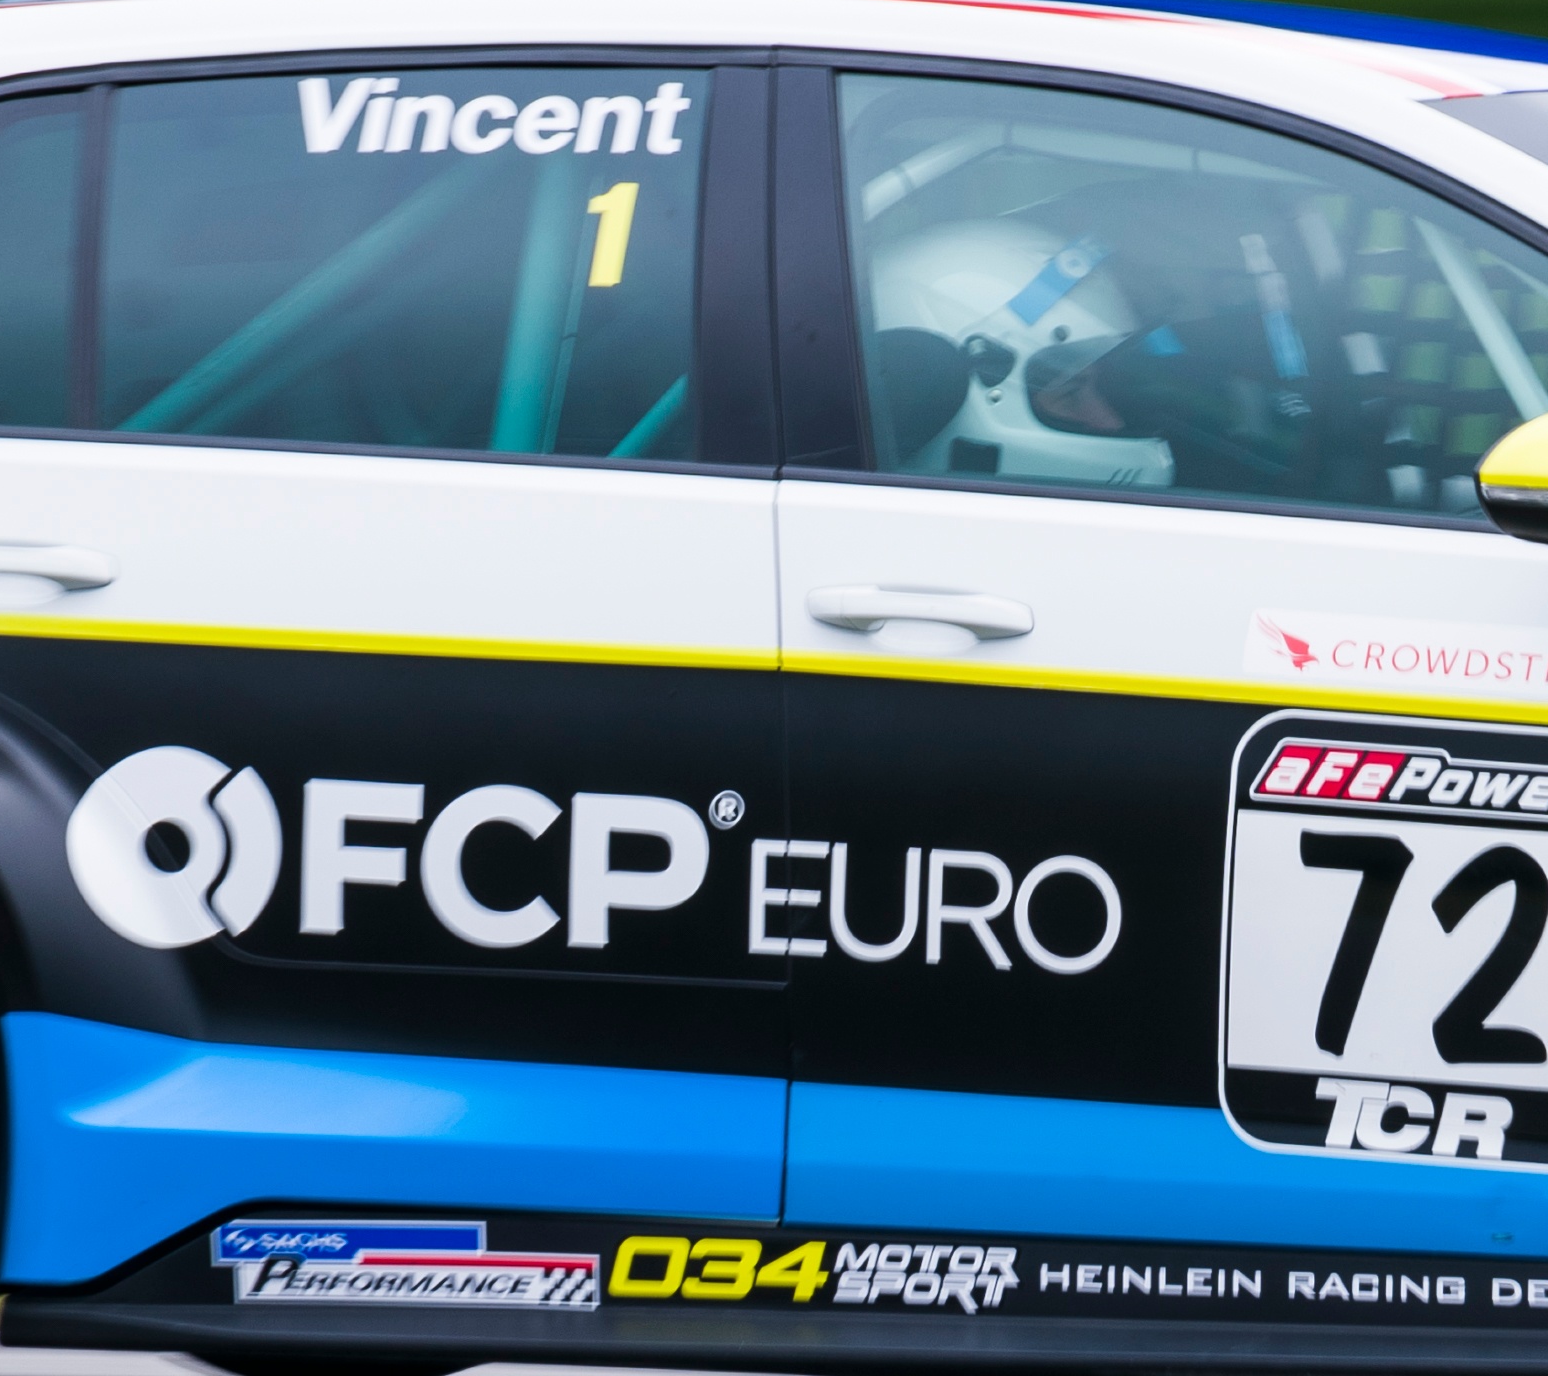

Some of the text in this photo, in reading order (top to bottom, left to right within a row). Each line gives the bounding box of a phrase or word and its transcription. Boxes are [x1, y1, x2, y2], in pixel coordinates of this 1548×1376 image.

[297, 76, 692, 155] Vincent
[587, 181, 640, 288] 1
[748, 839, 1123, 974] EURO
[1315, 1077, 1514, 1160] TCR
[246, 1254, 536, 1298] PERFORMANCE
[607, 1235, 1021, 1303] 034 MOTOR
[832, 1272, 1014, 1315] SPORT
[1038, 1262, 1262, 1301] HEINLEIN
[1286, 1270, 1468, 1306] RACING
